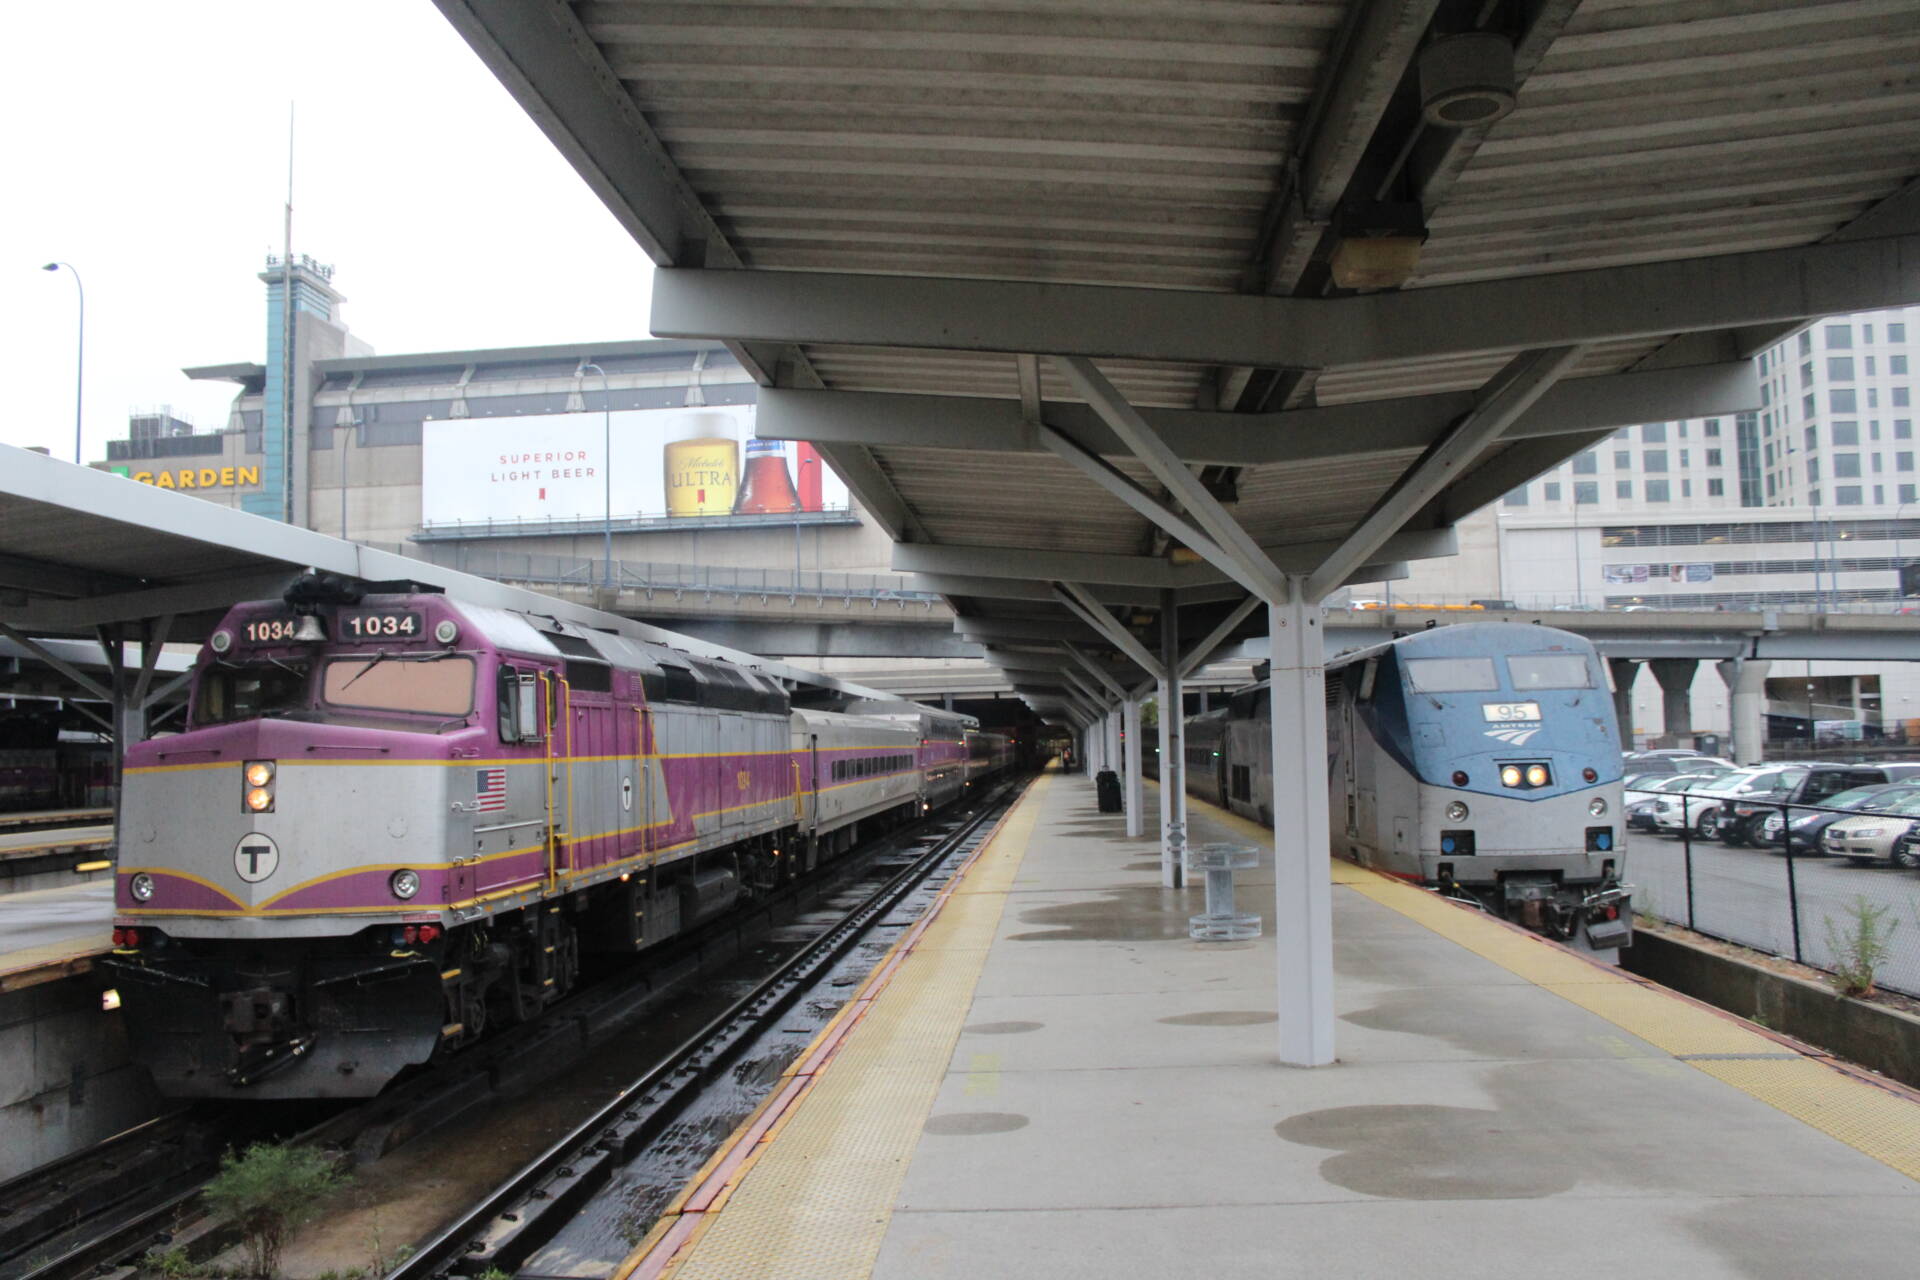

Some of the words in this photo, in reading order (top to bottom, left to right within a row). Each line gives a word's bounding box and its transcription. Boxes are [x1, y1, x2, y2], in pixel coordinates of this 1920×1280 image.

[499, 451, 587, 464] SUPERIOR
[133, 466, 258, 488] GARDEN
[491, 470, 541, 482] LIGHT
[551, 467, 594, 479] BEER
[672, 470, 732, 488] ULTRA
[247, 621, 295, 641] 1034
[350, 616, 415, 635] 1034
[1498, 705, 1527, 720] 95
[241, 845, 271, 875] T
